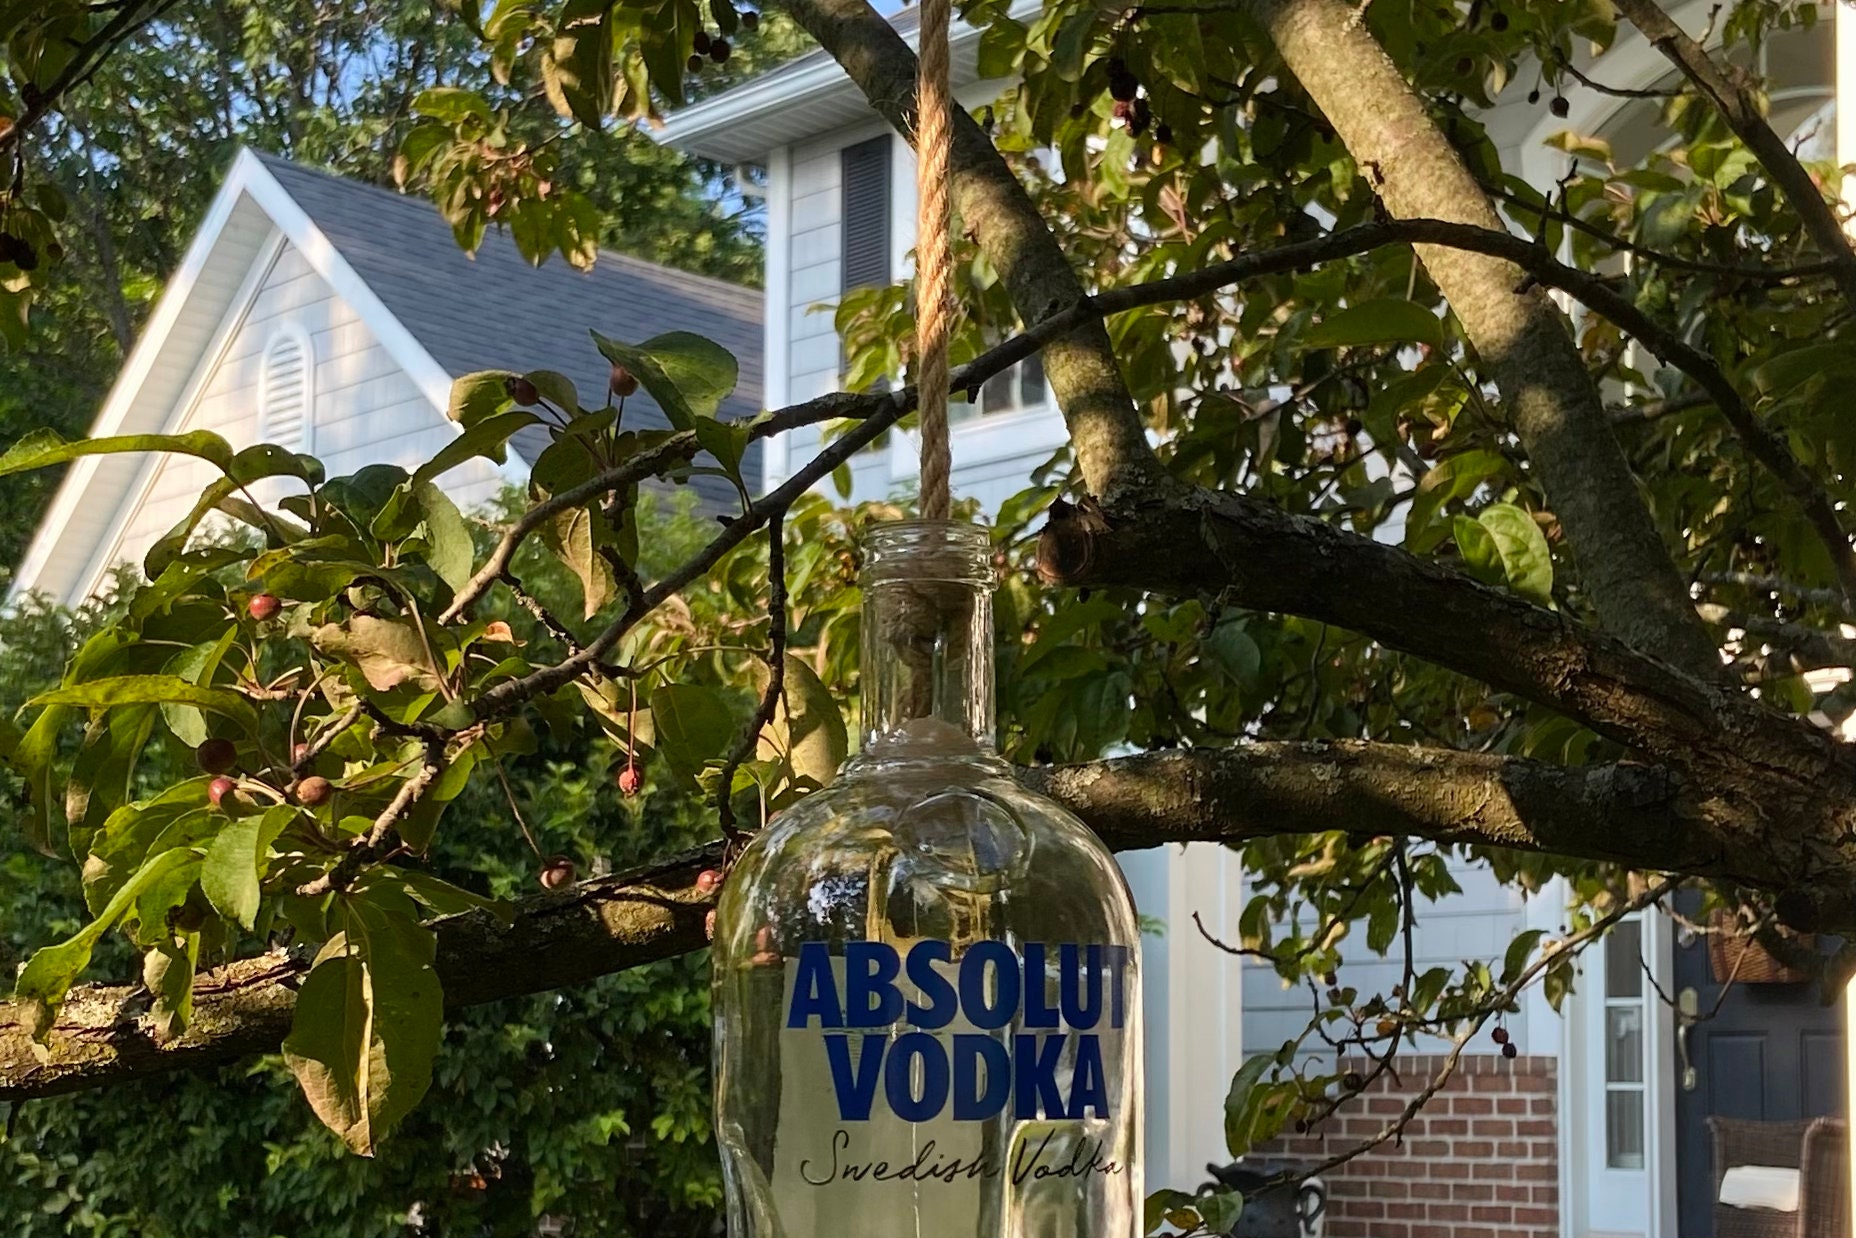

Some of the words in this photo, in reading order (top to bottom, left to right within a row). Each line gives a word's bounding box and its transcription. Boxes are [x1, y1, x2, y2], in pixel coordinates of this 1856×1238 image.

[787, 941, 1128, 1029] ABSOLUT
[823, 1033, 1111, 1122] VODKA
[800, 1129, 1003, 1186] Swedish
[1011, 1128, 1124, 1187] Vodka
